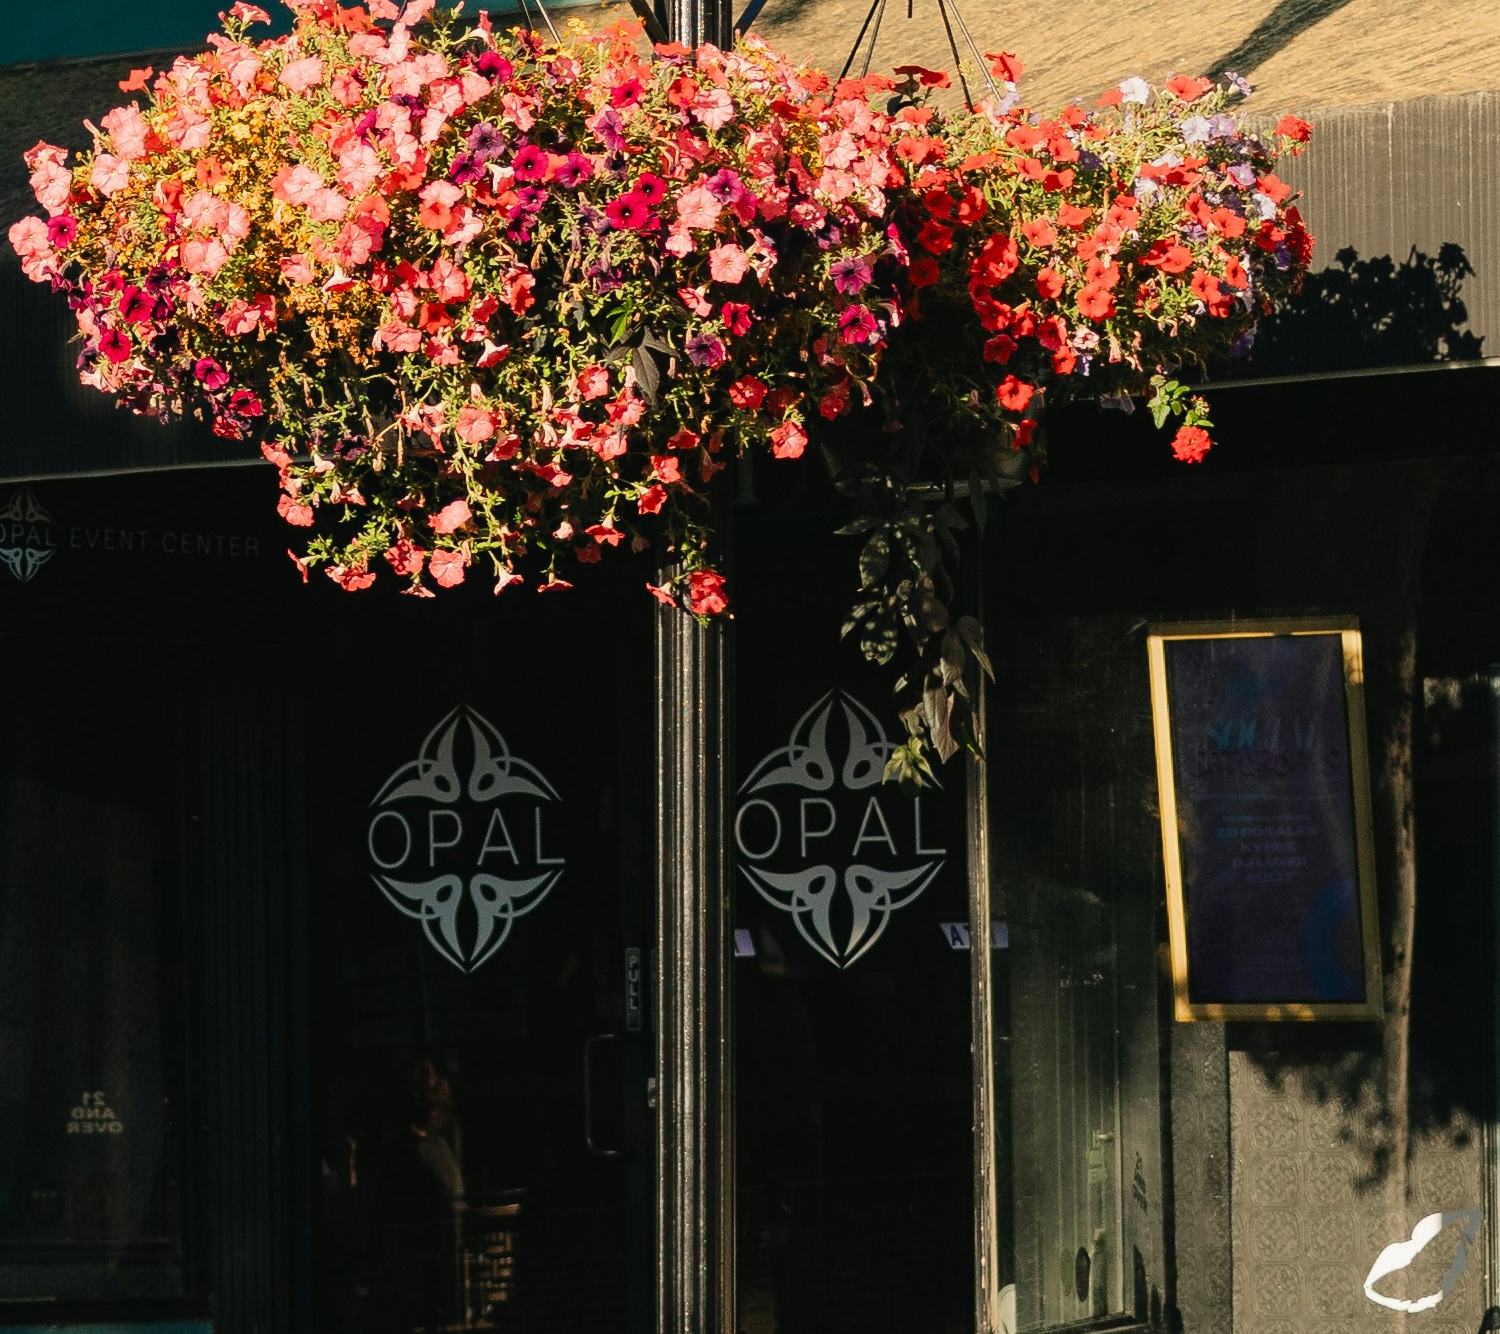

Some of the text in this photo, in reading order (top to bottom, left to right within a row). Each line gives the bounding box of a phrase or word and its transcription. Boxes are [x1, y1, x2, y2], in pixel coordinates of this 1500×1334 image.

[70, 526, 149, 551] EVENT
[161, 532, 260, 557] CENTER
[368, 806, 566, 869] OPAL
[735, 796, 948, 860] OPAL
[627, 954, 639, 1010] PULL
